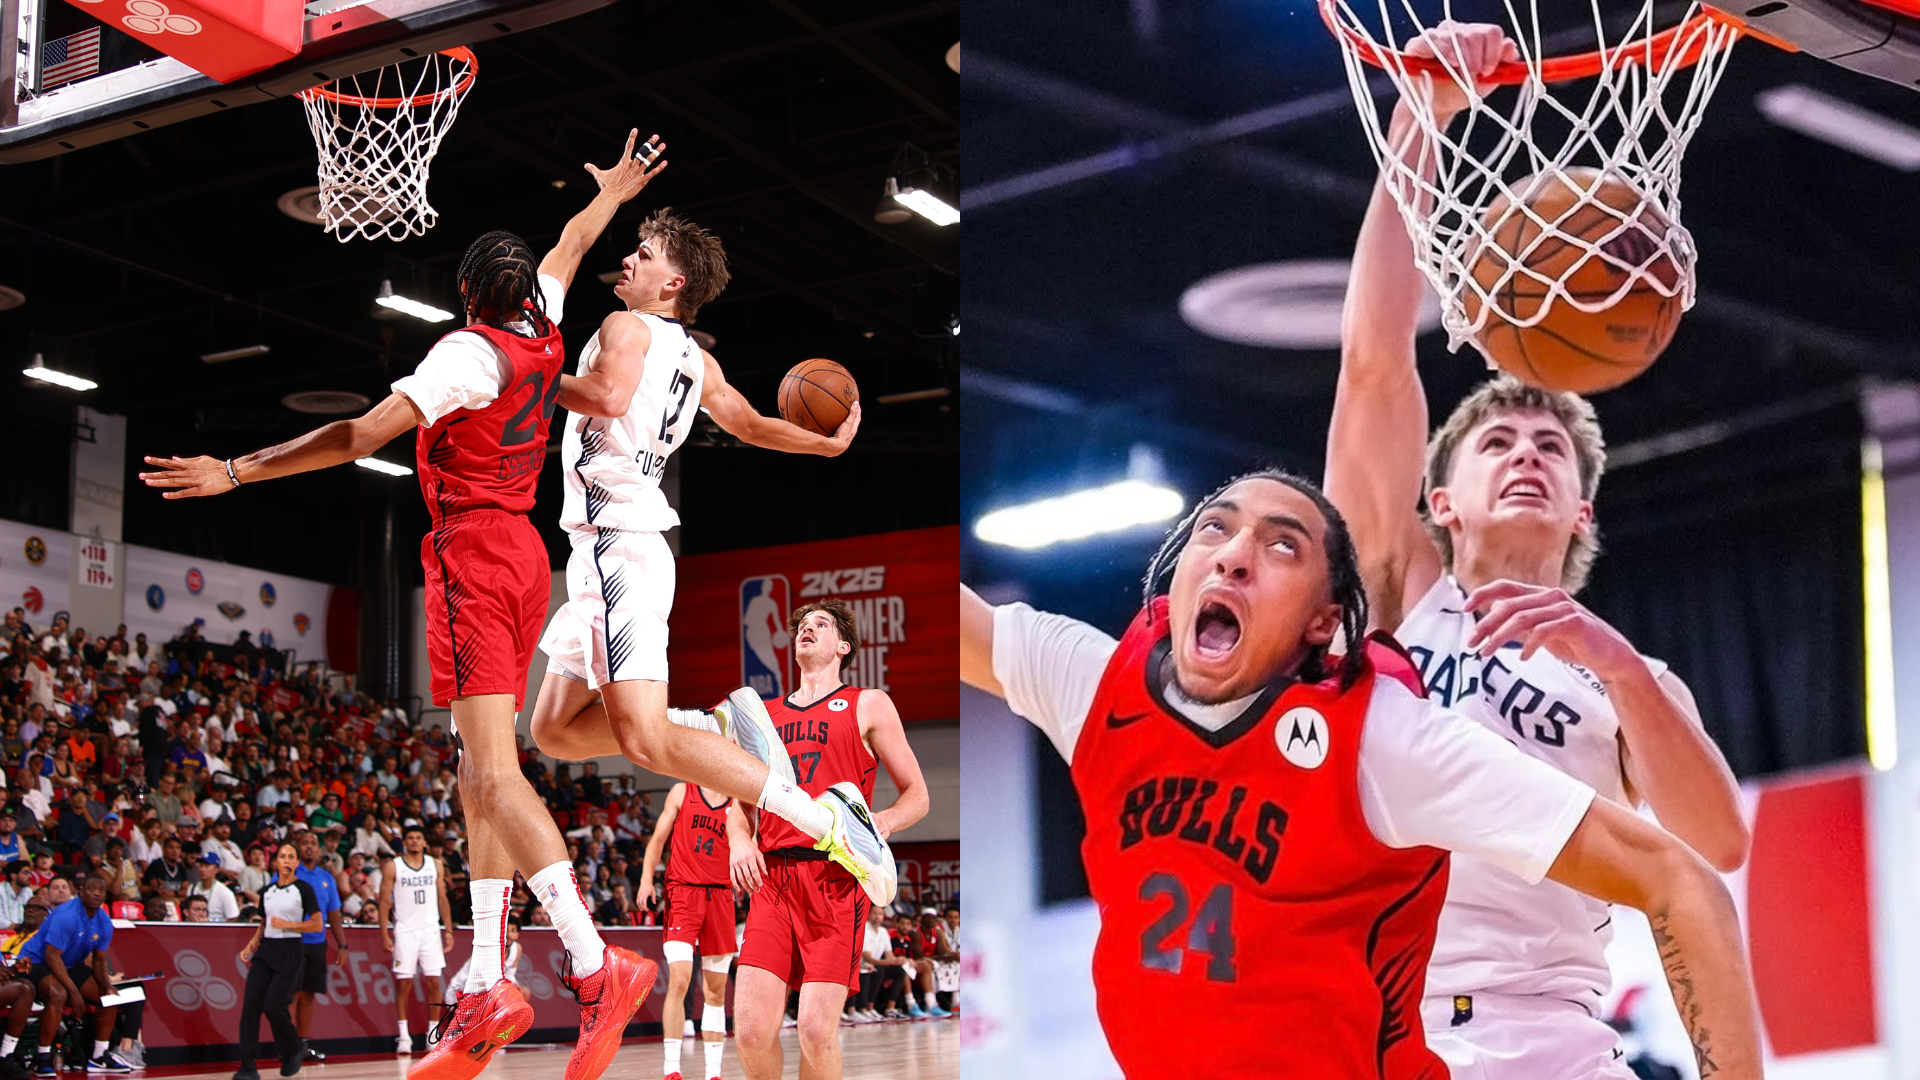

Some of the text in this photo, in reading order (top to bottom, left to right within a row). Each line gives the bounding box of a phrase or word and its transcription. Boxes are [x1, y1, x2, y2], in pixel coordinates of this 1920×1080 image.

[88, 545, 106, 562] 118
[87, 568, 105, 584] 119
[800, 565, 885, 598] 2K26
[845, 595, 906, 646] MER
[842, 646, 890, 693] GUE
[750, 674, 774, 695] NBA
[691, 814, 726, 839] BULLS
[1119, 777, 1289, 886] BULLS
[694, 834, 715, 857] 14
[401, 875, 434, 888] PACERS
[414, 889, 426, 905] 10
[1139, 870, 1238, 984] 24
